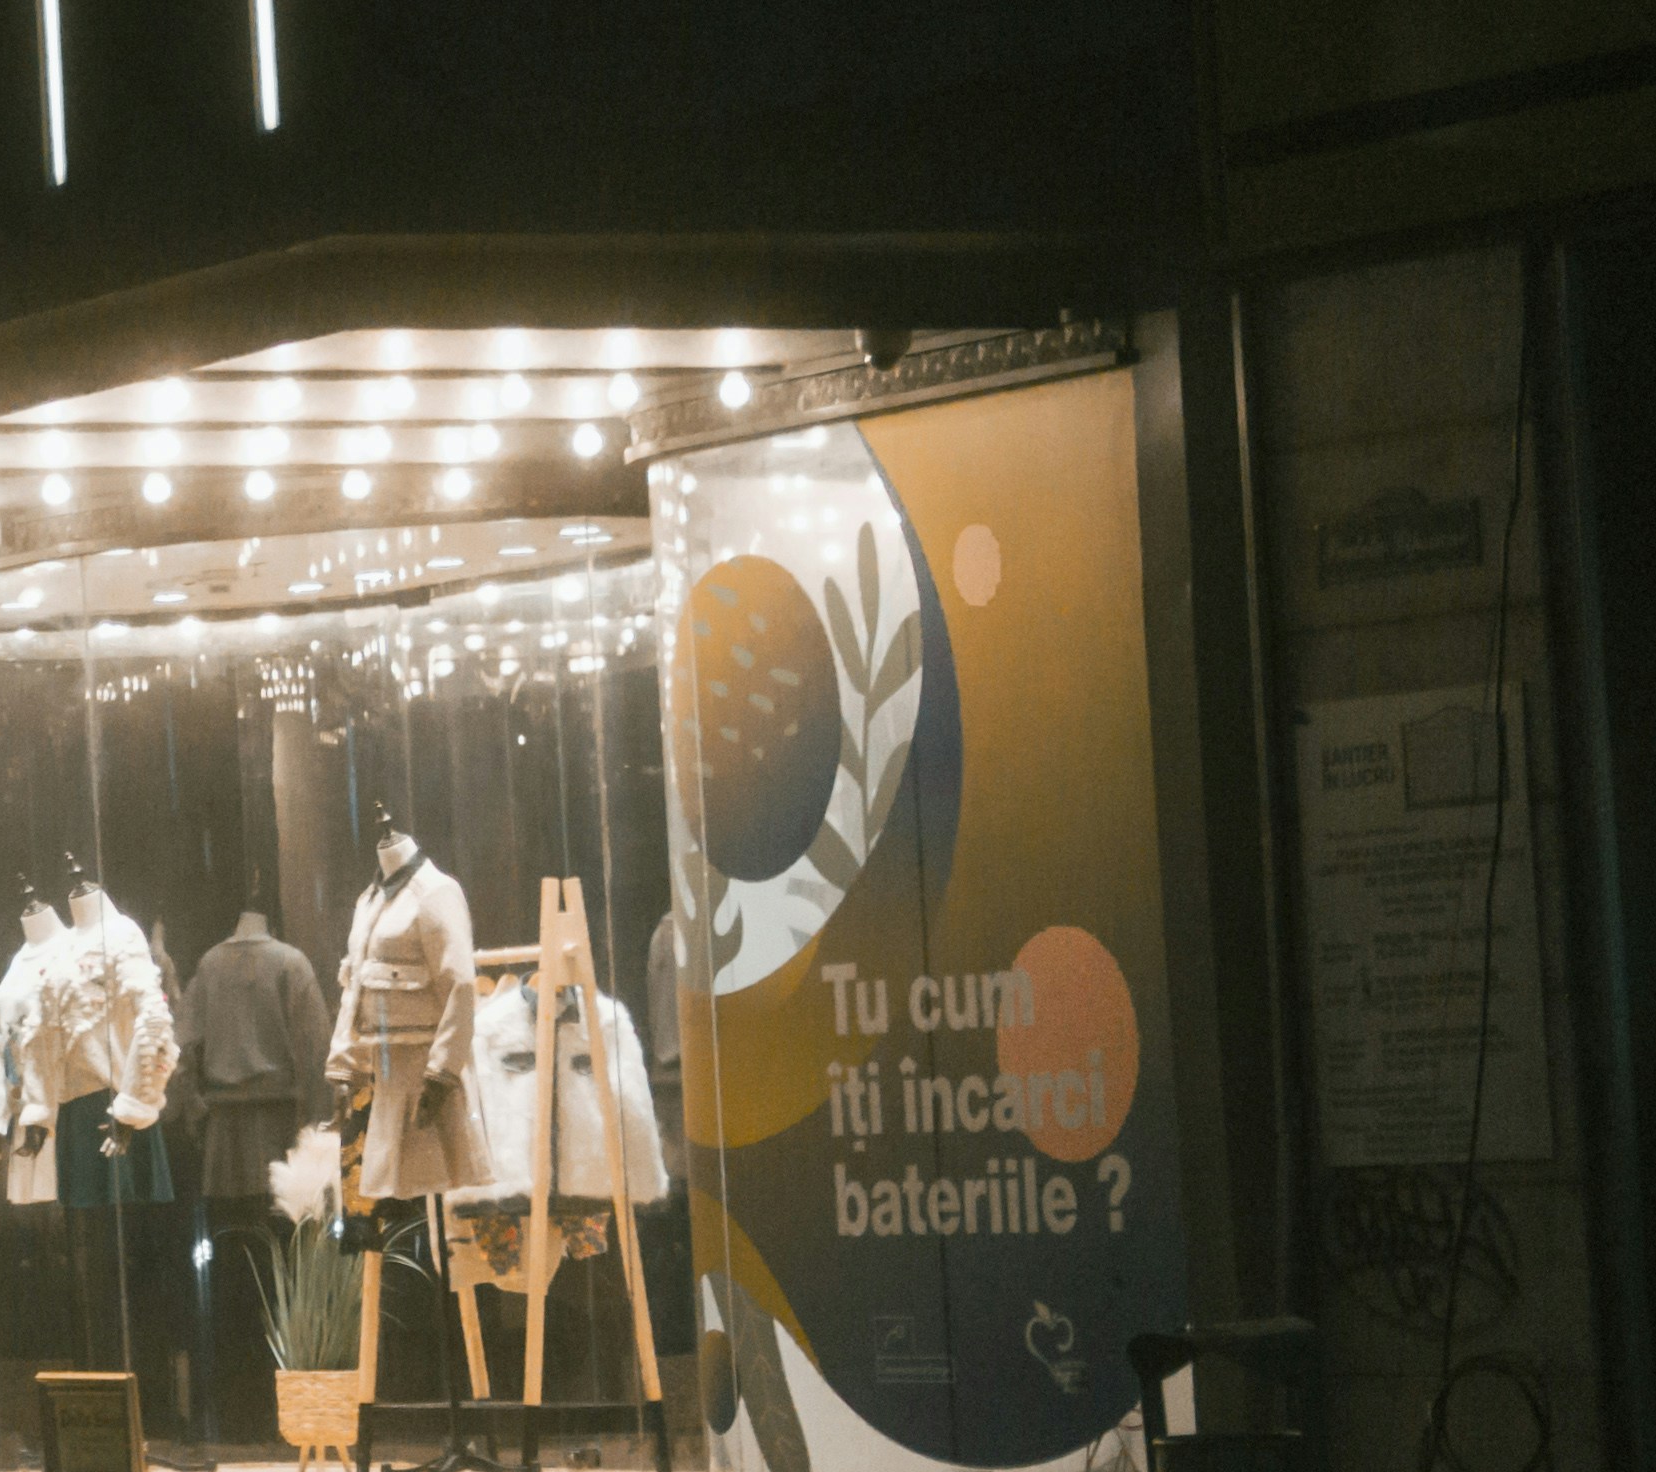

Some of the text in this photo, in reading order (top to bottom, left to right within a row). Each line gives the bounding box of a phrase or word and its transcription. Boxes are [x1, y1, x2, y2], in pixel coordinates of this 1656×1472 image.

[821, 962, 1035, 1035] Tu cum
[899, 1050, 1106, 1133] încarci
[834, 1154, 1131, 1237] bateriile ?
